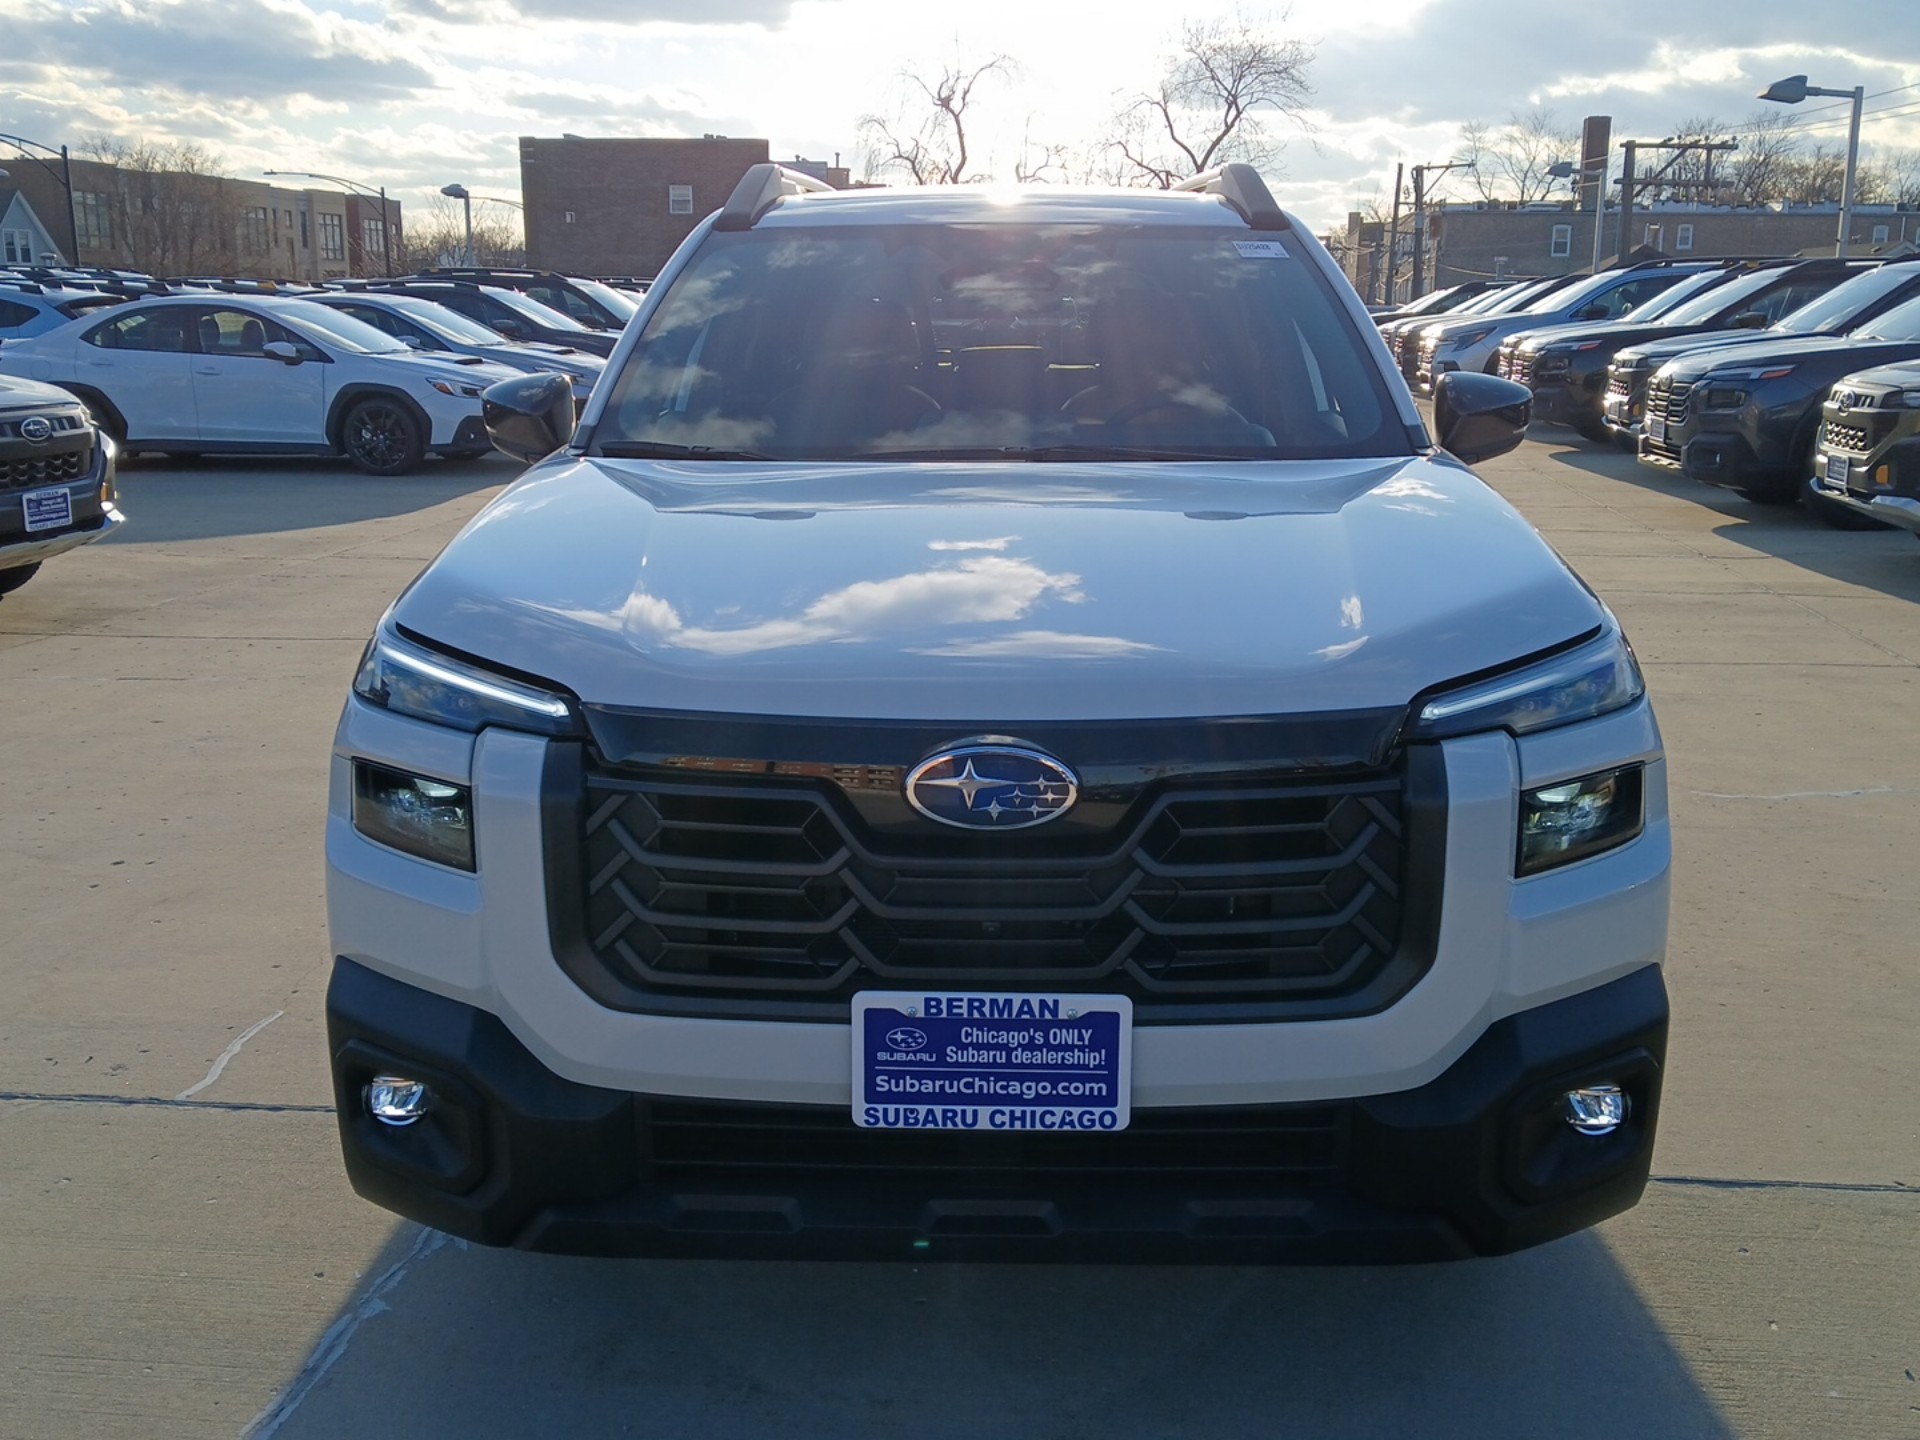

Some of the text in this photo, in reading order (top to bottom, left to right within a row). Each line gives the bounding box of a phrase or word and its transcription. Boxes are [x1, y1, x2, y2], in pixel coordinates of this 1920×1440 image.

[924, 997, 1060, 1019] BERMAN
[961, 1026, 1092, 1048] Chicago's ONLY
[876, 1051, 936, 1062] SUBARU
[946, 1046, 1106, 1068] Subaru dealership!
[875, 1075, 1107, 1099] SubaruChicago.com
[864, 1107, 1118, 1130] SUBARU CHICAGO
